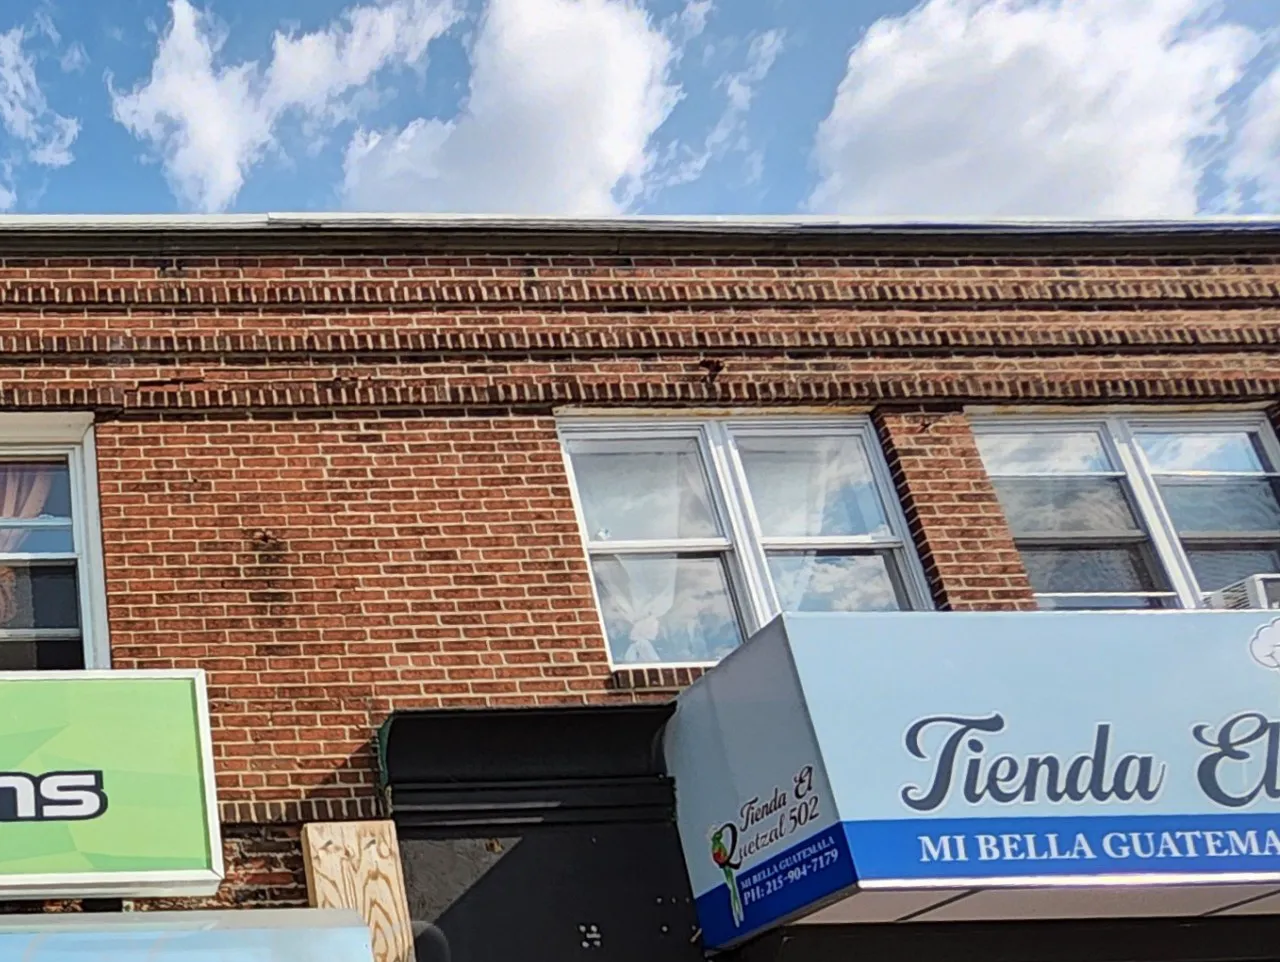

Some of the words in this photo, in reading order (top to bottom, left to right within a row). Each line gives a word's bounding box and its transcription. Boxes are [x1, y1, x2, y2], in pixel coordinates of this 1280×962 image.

[901, 713, 1166, 812] Tienda
[1192, 712, 1280, 808] El
[740, 787, 787, 832] Tienda
[794, 765, 813, 799] El
[716, 814, 786, 870] Quetzal
[789, 796, 820, 833] 502
[740, 879, 752, 891] MI
[753, 863, 779, 884] BELLA
[779, 836, 835, 871] GUATEMALA
[918, 835, 968, 862] MI
[975, 832, 1097, 861] BELLA
[1102, 829, 1280, 860] GUATEMA
[743, 884, 765, 906] PH:
[766, 848, 839, 896] 215-904-7179
